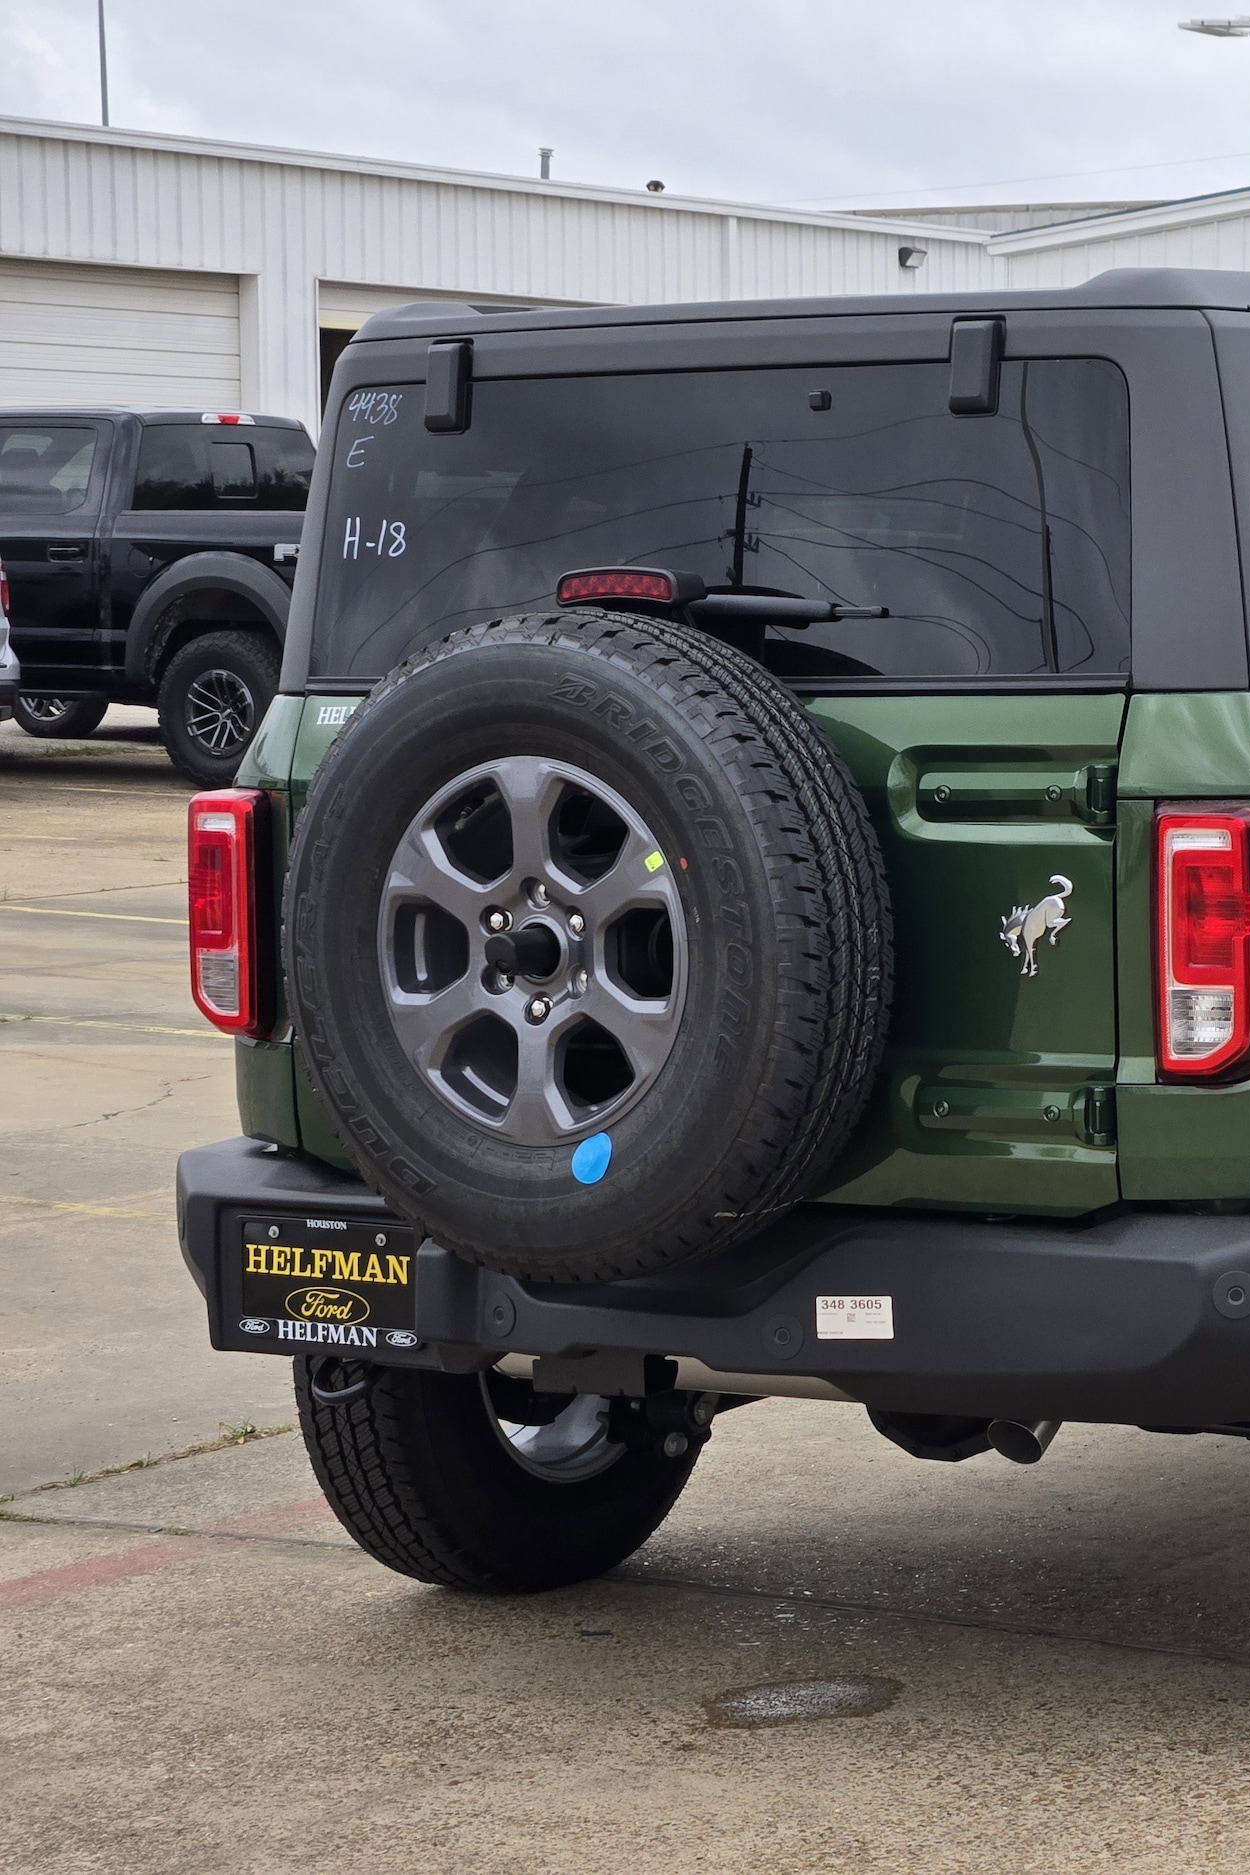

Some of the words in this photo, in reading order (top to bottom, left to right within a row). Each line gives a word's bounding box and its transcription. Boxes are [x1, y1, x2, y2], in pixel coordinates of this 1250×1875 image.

[346, 435, 374, 468] E
[343, 517, 407, 559] H-18
[547, 672, 754, 1077] BRIDGESTONE
[306, 1219, 348, 1230] HOUSTON
[245, 1244, 411, 1285] HELFMAN
[301, 1290, 353, 1320] Ford
[821, 1300, 845, 1310] 348
[850, 1300, 882, 1310] 3605
[277, 1319, 378, 1347] HELFMAN
